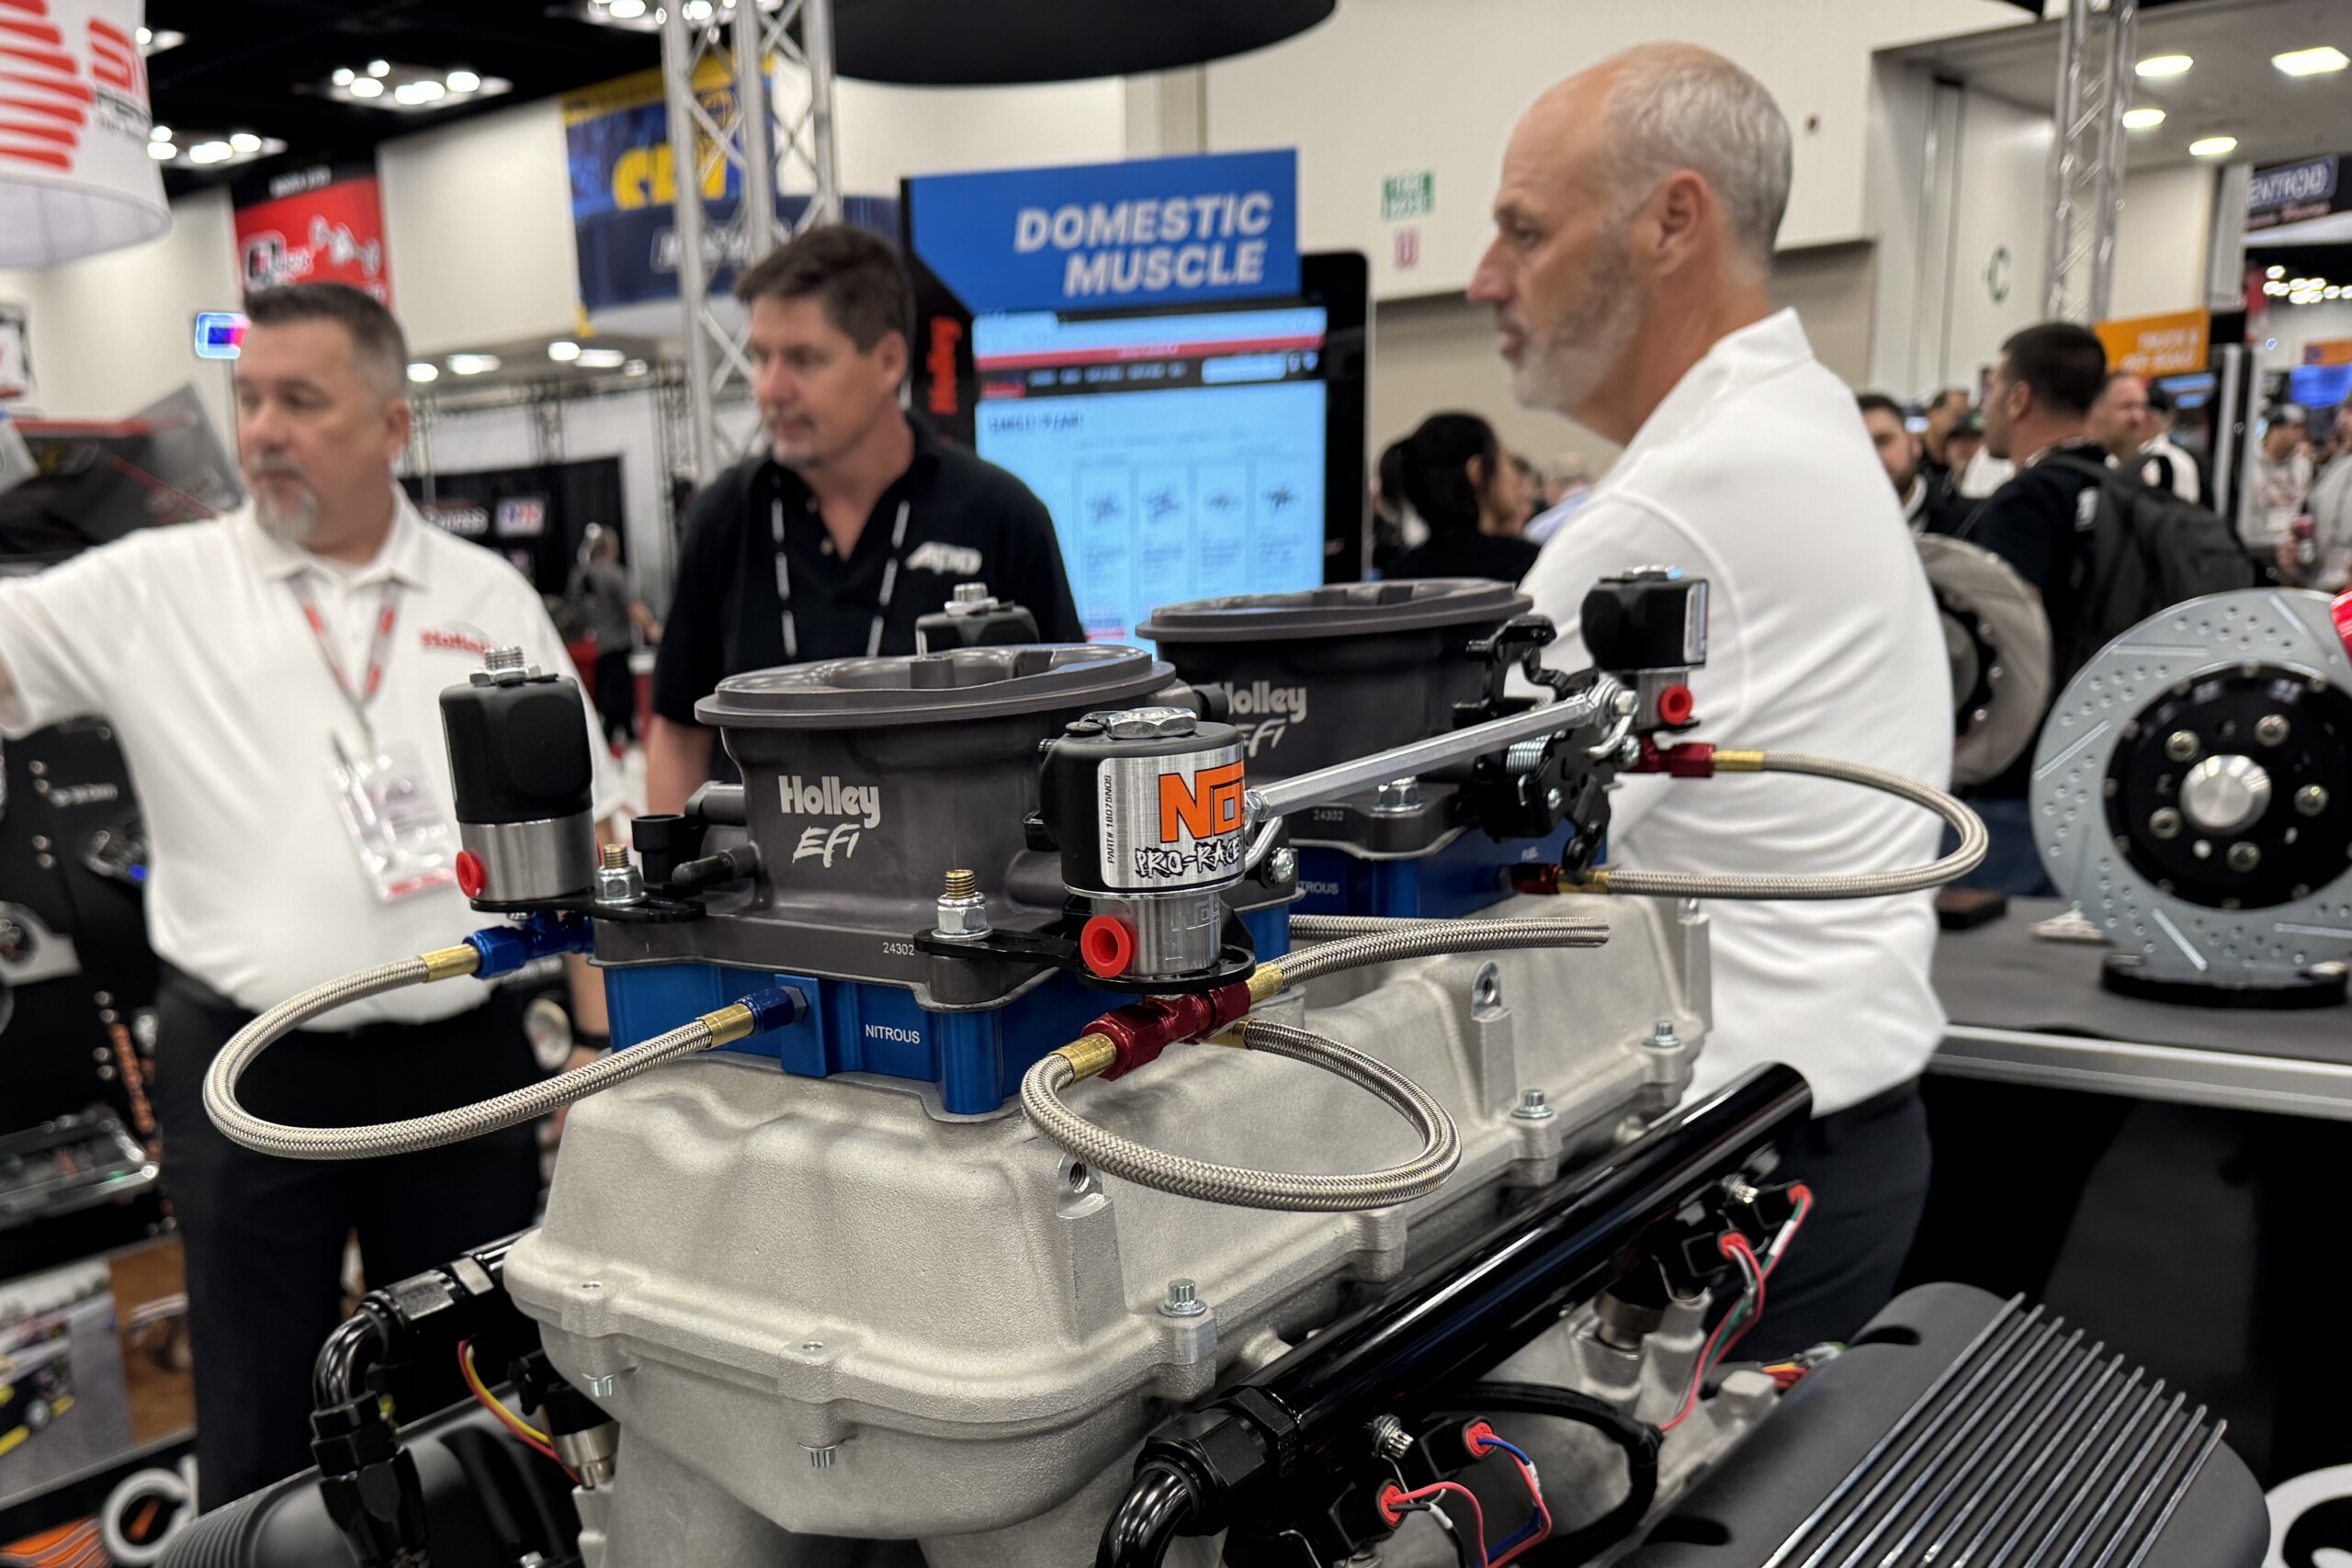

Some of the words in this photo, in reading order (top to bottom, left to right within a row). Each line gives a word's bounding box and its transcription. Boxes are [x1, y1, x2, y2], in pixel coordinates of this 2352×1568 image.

[1013, 190, 1273, 254] DOMESTIC
[1063, 239, 1268, 297] MUSCLE
[778, 775, 881, 829] Holley
[1159, 759, 1245, 843] NO
[792, 823, 861, 868] EFI
[1106, 831, 1114, 863] PART#
[1135, 835, 1241, 878] PRO-RACE
[1296, 880, 1340, 895] TROUS
[883, 942, 915, 955] 24302
[865, 1024, 921, 1043] NITROUS
